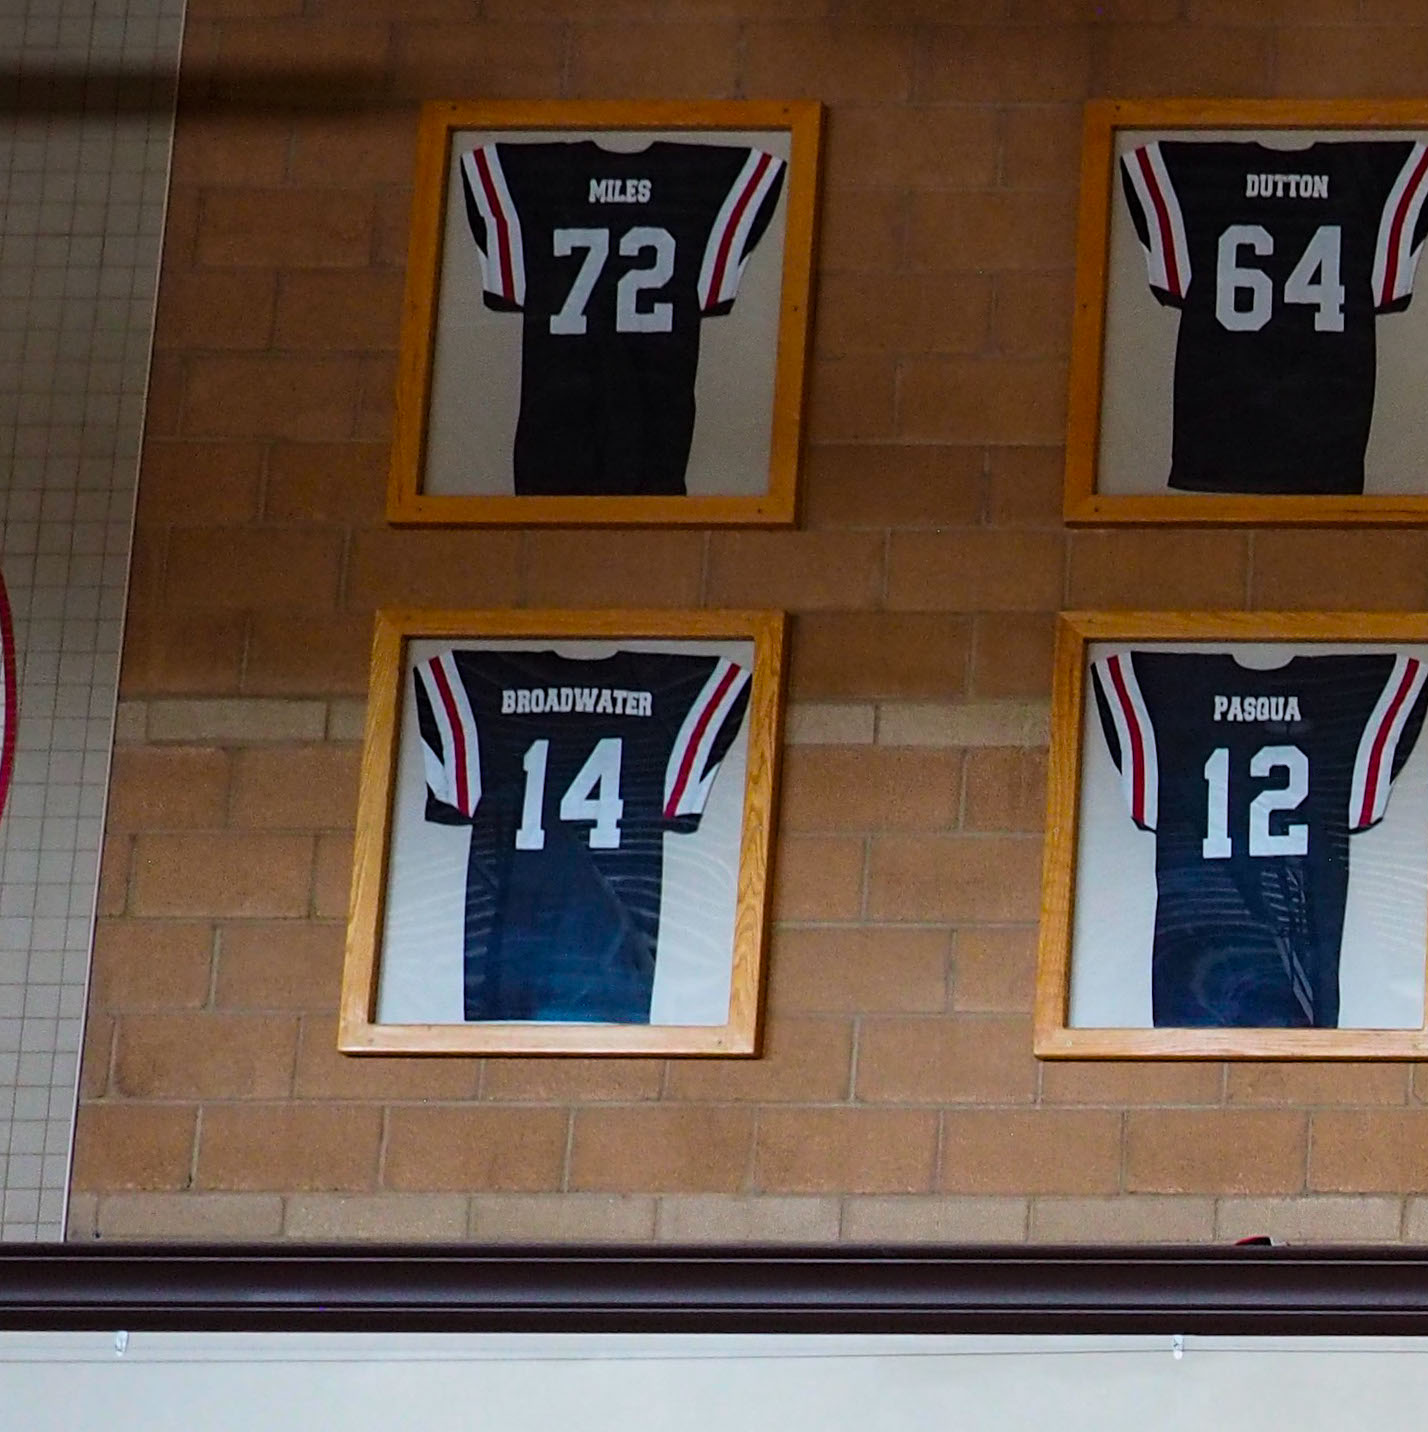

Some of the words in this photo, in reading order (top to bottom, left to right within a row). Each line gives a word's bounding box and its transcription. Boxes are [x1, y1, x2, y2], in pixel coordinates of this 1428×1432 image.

[588, 178, 652, 204] MILES
[1245, 173, 1329, 199] DUTTON
[549, 226, 676, 335] 72
[1215, 224, 1346, 333] 64
[501, 687, 653, 717] BROADWATER
[1213, 695, 1302, 722] PASQUA
[515, 737, 624, 850] 14
[1202, 745, 1309, 859] 12
